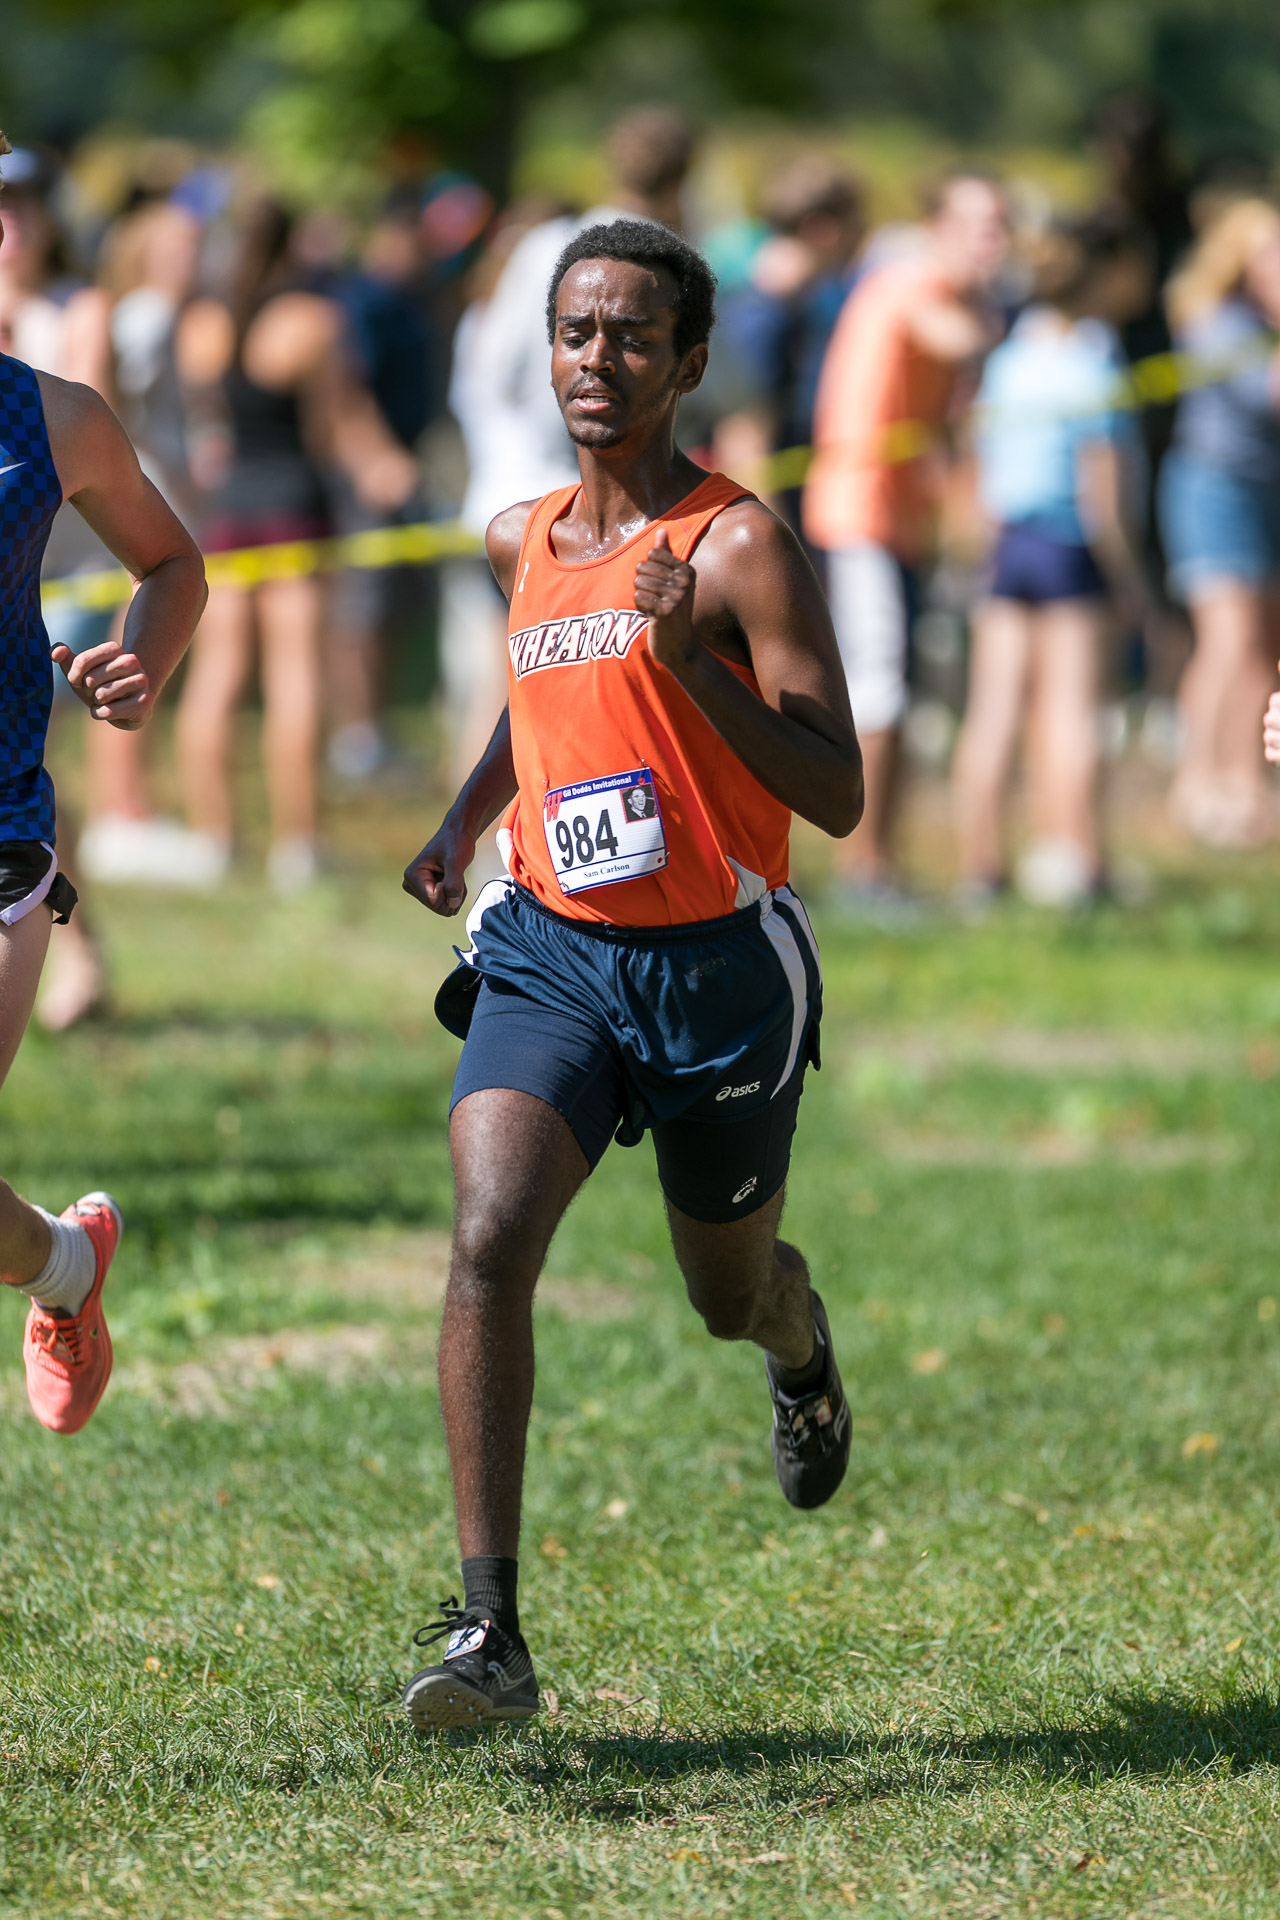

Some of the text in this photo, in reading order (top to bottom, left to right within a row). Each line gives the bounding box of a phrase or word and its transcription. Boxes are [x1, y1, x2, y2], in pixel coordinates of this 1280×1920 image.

[509, 608, 650, 683] WHEATON
[563, 775, 632, 798] Gil Dodds Invitational
[545, 791, 563, 822] W
[555, 809, 619, 868] 984
[583, 863, 630, 879] Sam Carlson
